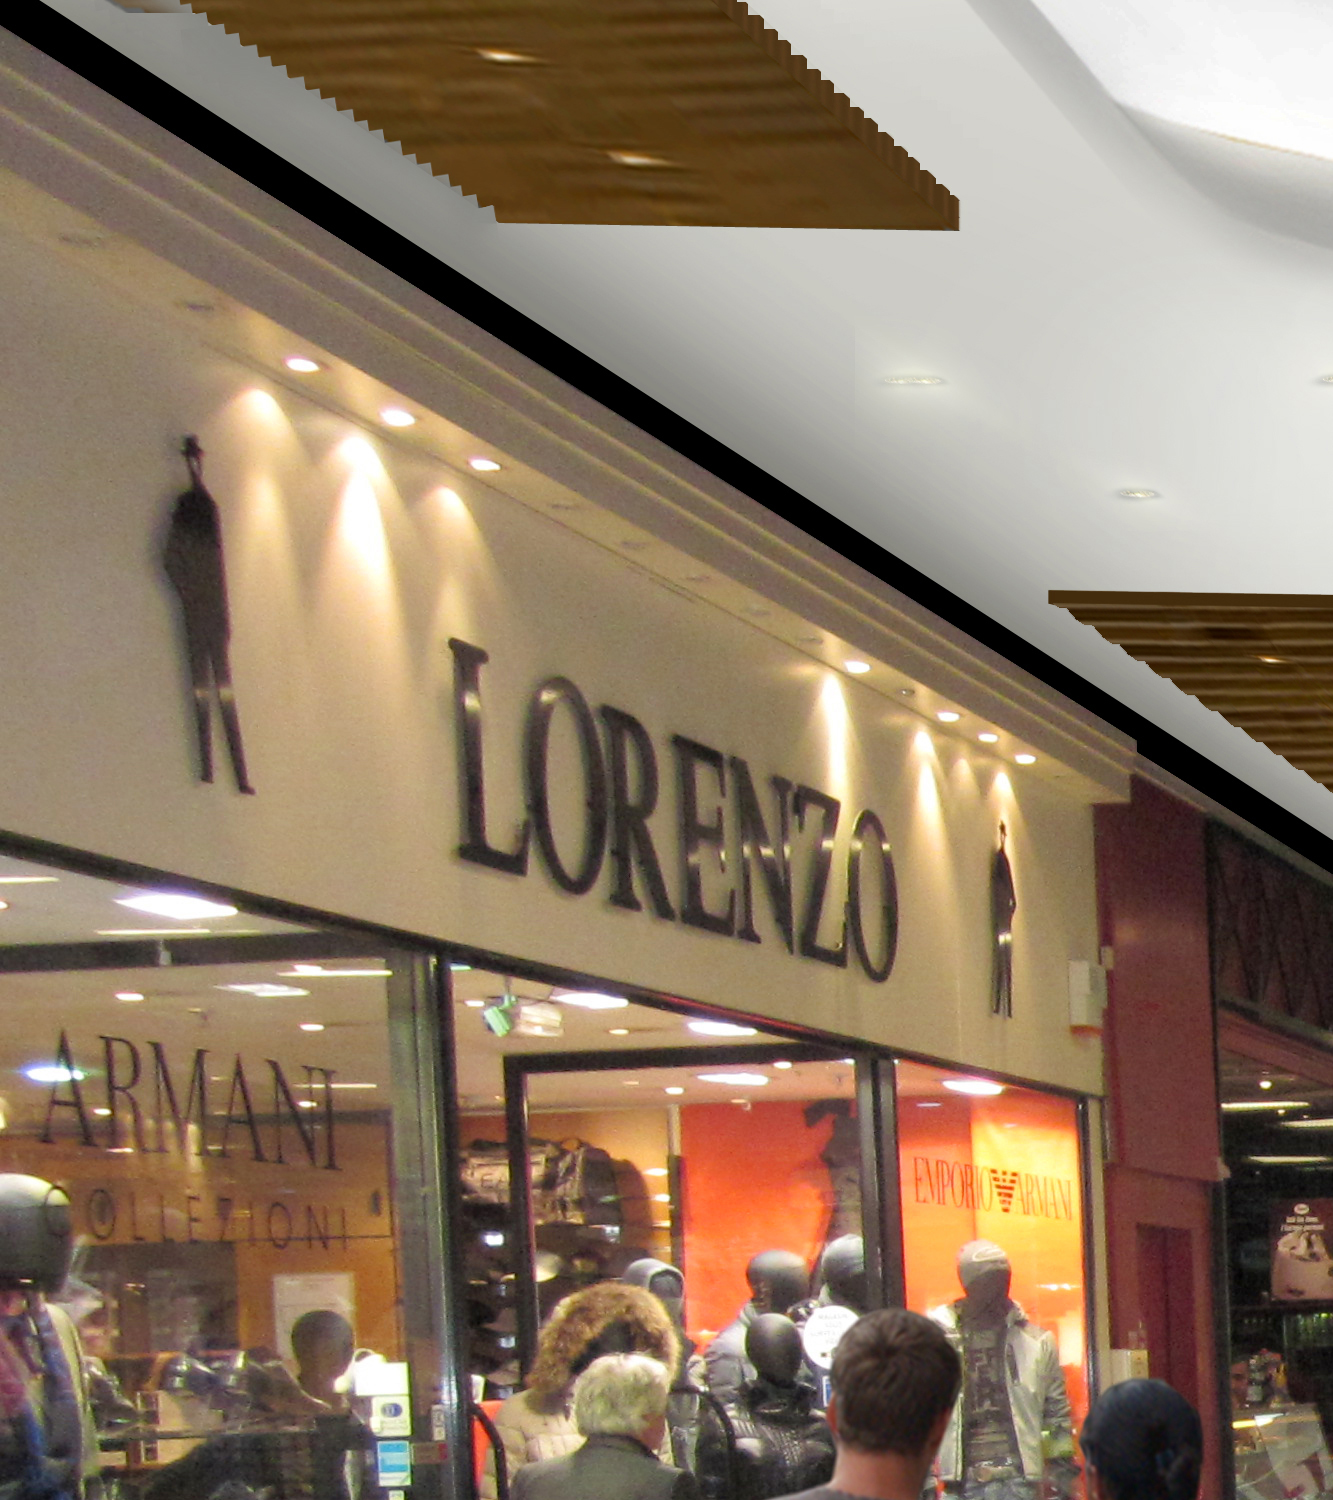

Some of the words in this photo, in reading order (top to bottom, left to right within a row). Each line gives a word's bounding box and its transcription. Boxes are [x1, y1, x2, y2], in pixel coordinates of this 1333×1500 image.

[448, 637, 898, 983] LORENZO
[38, 1030, 342, 1171] ARMANI
[913, 1156, 993, 1213] EMPORIO
[1014, 1171, 1073, 1221] ARMANI
